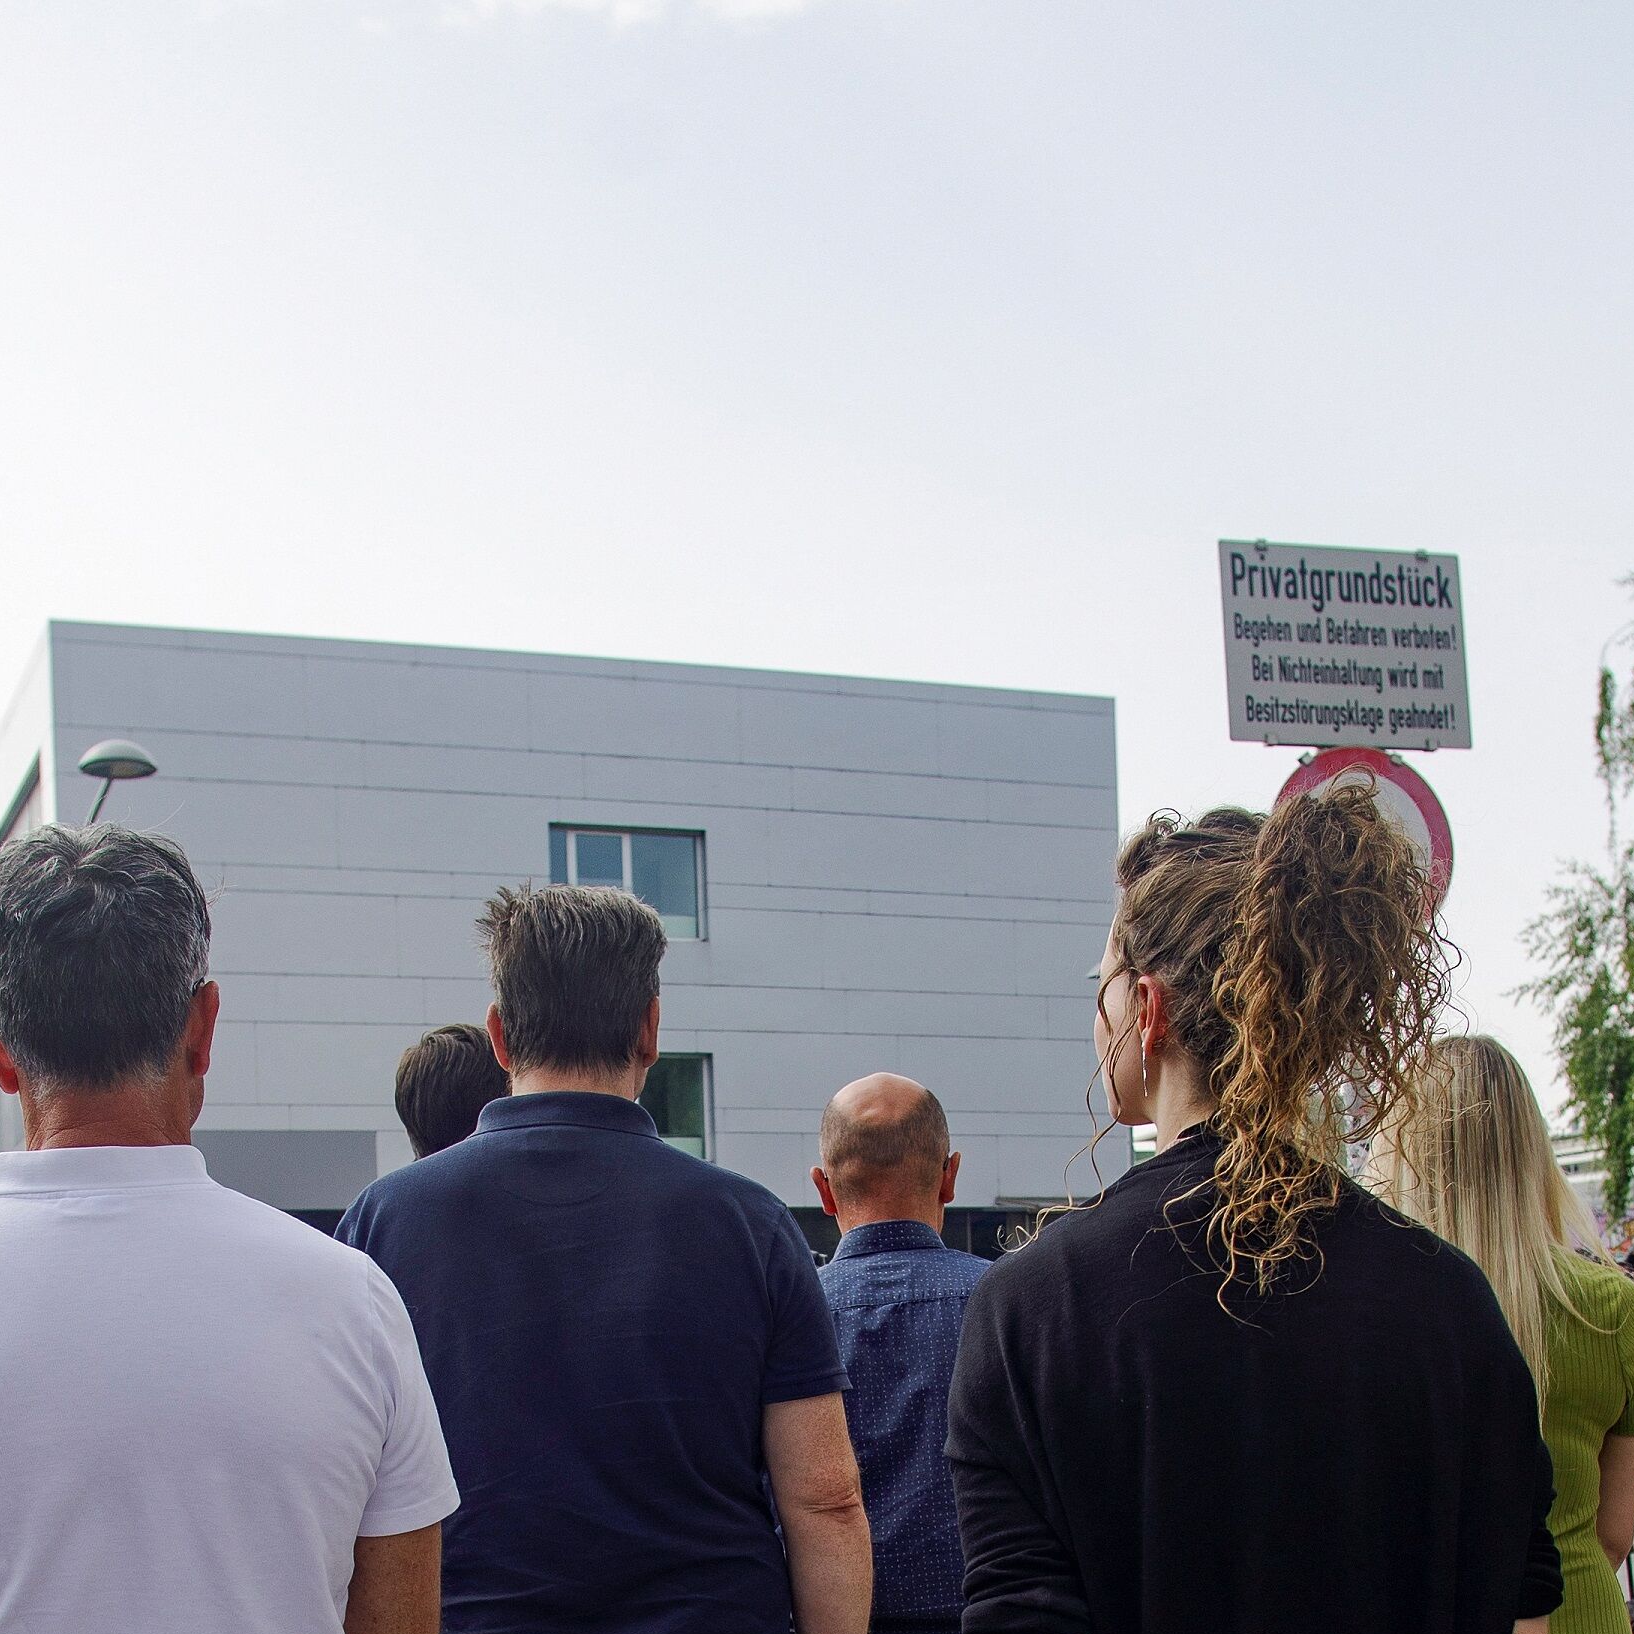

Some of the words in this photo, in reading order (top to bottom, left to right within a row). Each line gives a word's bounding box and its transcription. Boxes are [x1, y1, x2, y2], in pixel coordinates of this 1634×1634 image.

[1231, 552, 1453, 611] Privatgrundstück
[1234, 612, 1292, 647] Begehen
[1297, 617, 1322, 643] und
[1326, 616, 1387, 646] Befahren
[1391, 624, 1456, 651] verboten!
[1252, 654, 1274, 681] Bei
[1278, 656, 1383, 693] Nichteinhaltung
[1387, 661, 1418, 689] wird
[1422, 663, 1445, 690] mit
[1245, 695, 1384, 734] Besitzstörungsklage
[1389, 702, 1456, 735] geahndet!
